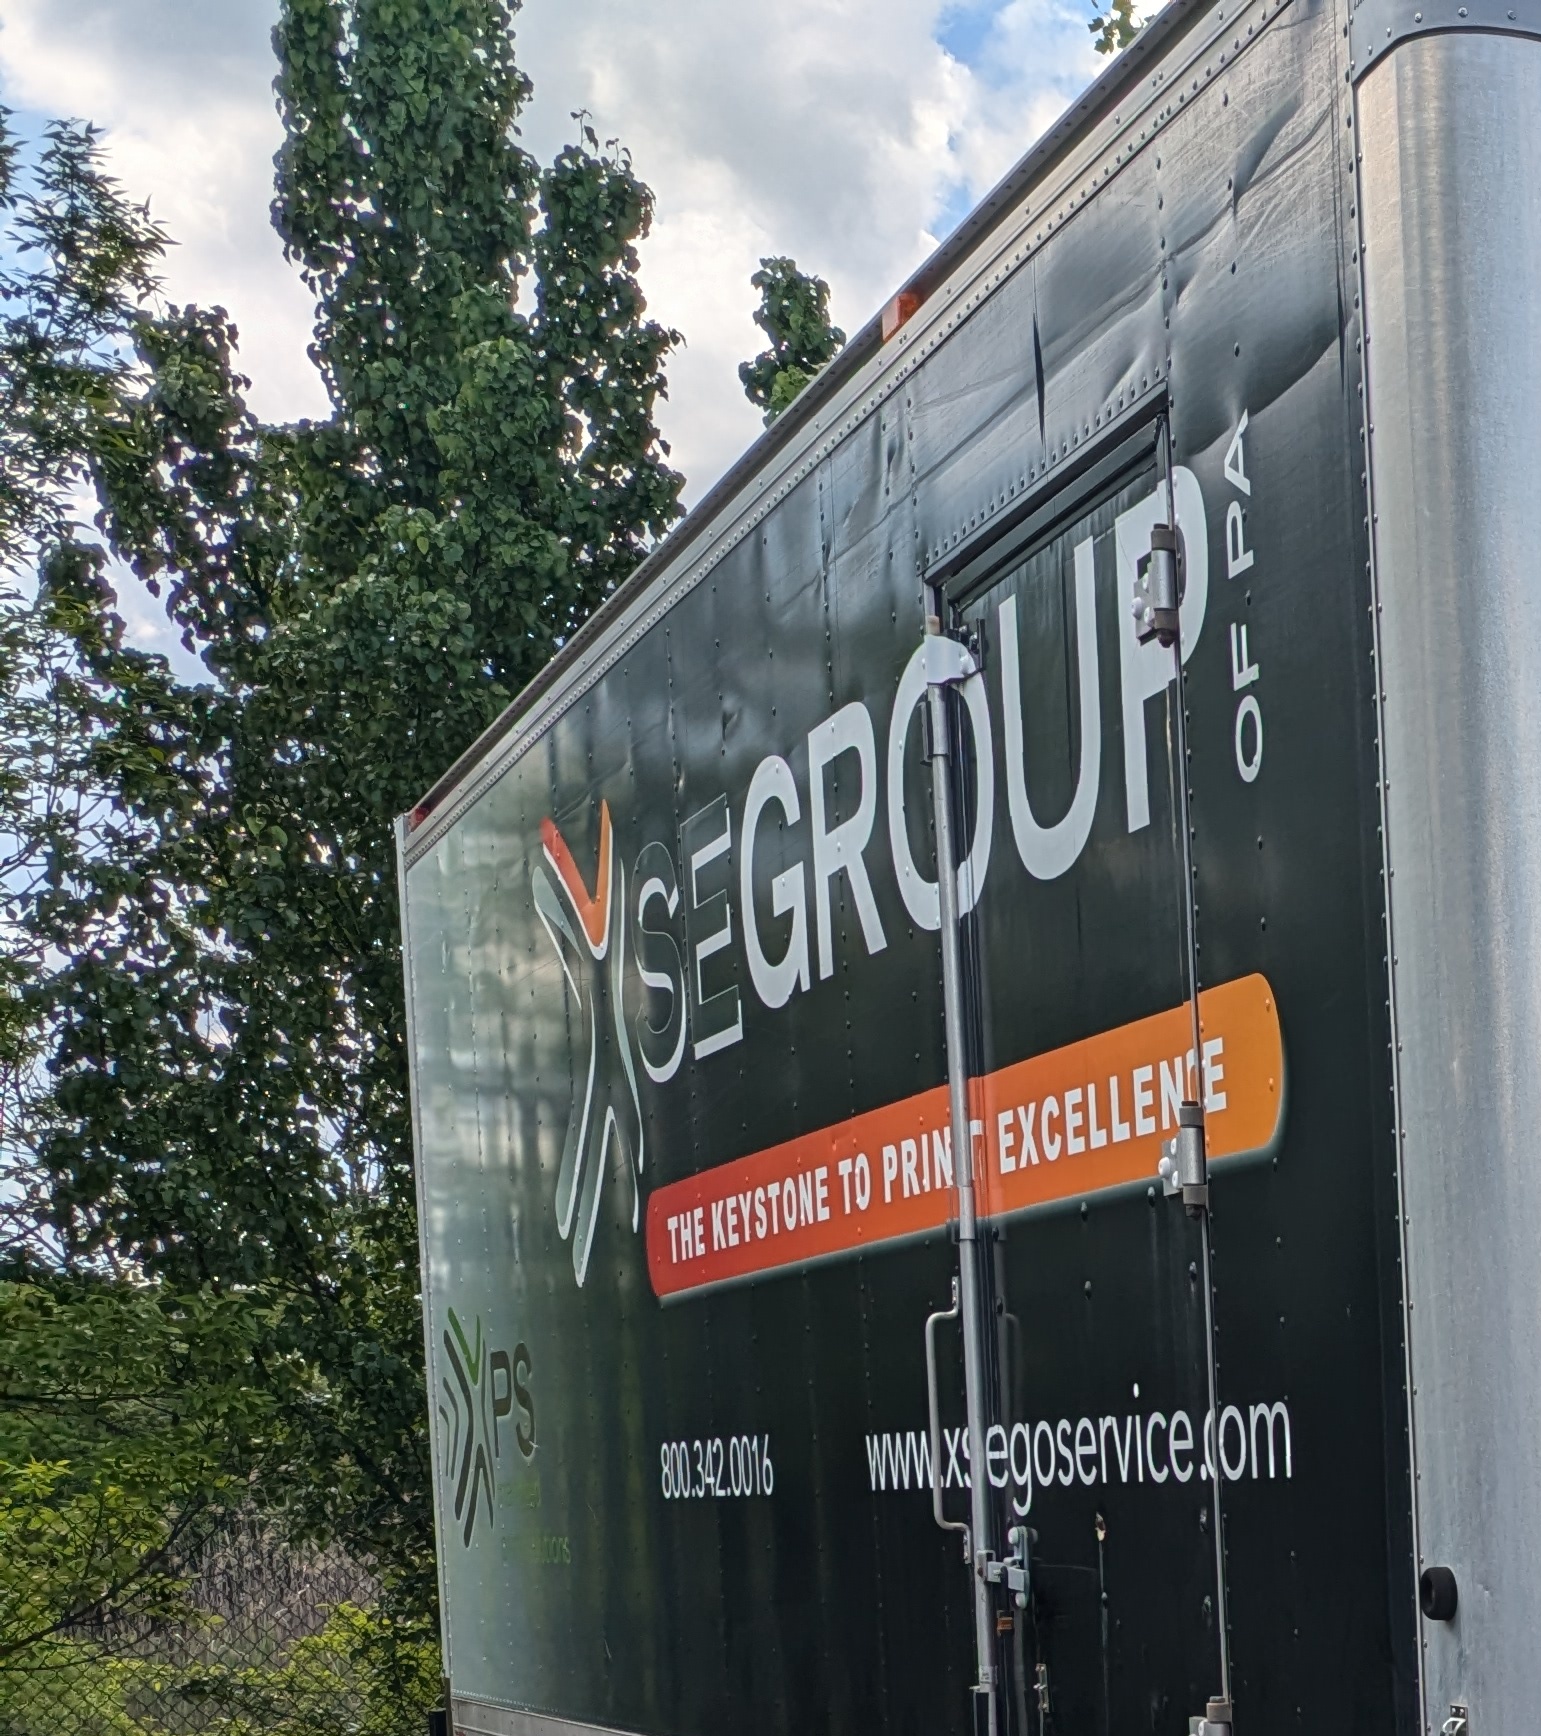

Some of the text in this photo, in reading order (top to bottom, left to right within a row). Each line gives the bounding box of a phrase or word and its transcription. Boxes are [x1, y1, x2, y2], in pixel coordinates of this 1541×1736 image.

[1223, 408, 1264, 783] OF PA
[666, 1207, 706, 1264] THE
[710, 1165, 831, 1252] KEYSTONE
[838, 1152, 871, 1215] TO
[660, 1434, 774, 1499] 800.342.0016
